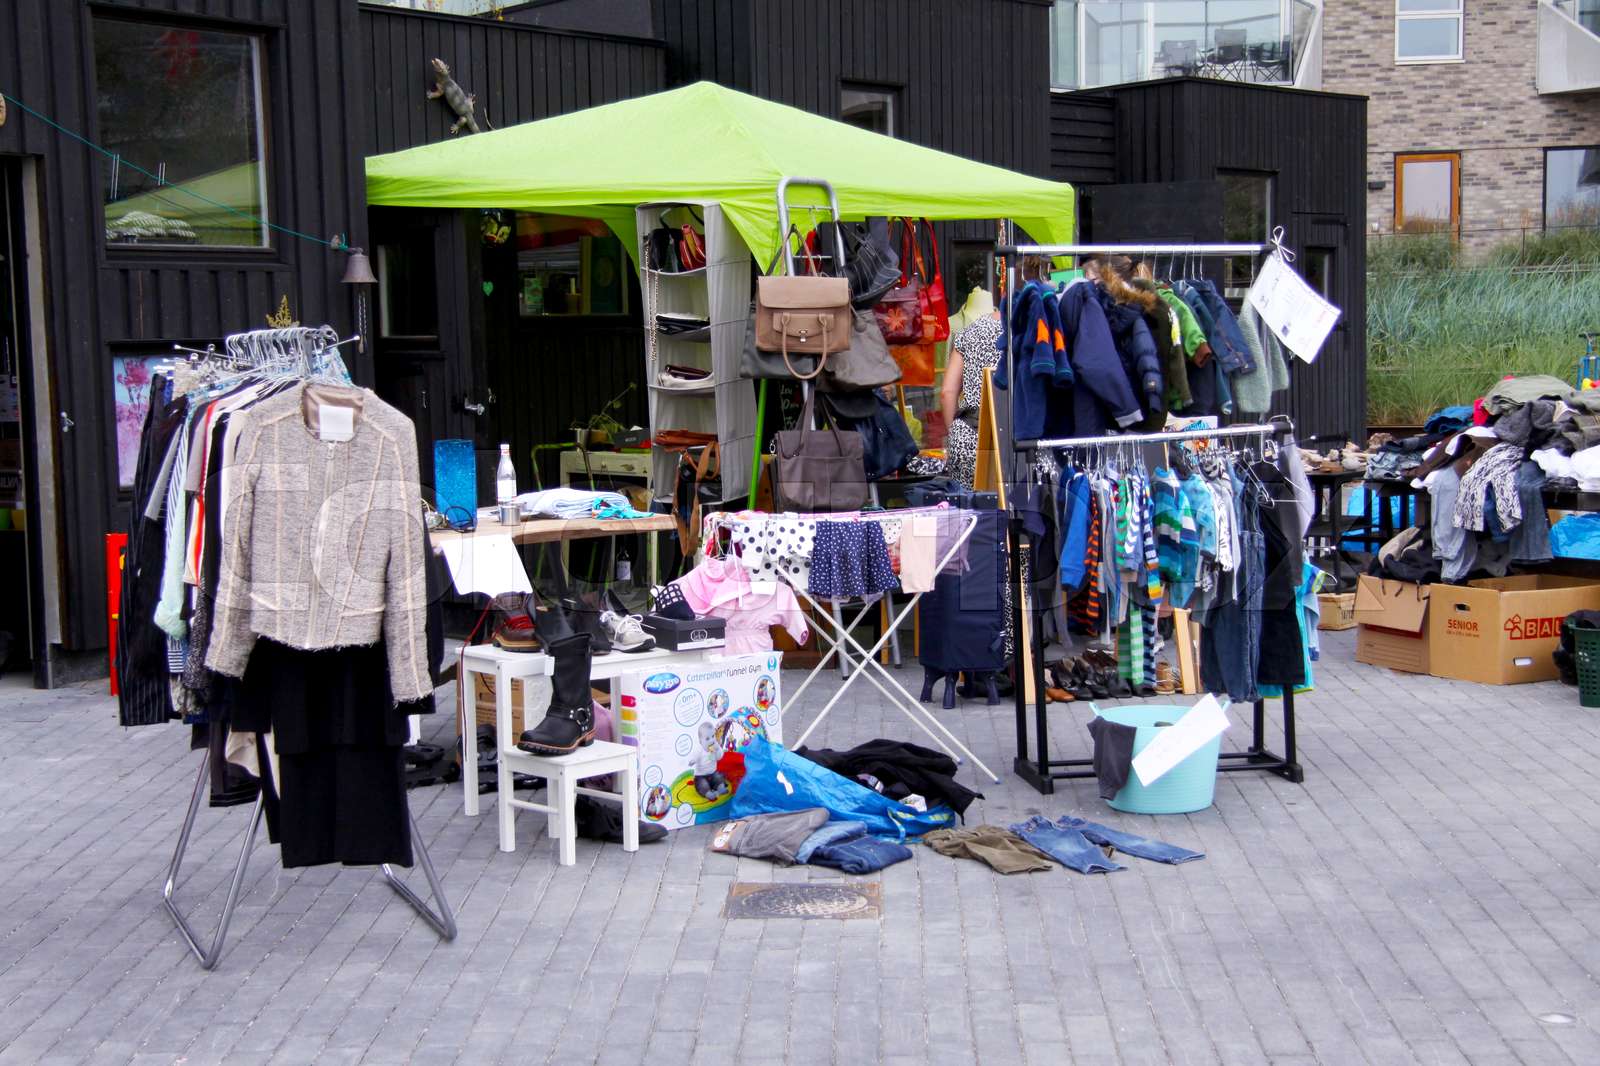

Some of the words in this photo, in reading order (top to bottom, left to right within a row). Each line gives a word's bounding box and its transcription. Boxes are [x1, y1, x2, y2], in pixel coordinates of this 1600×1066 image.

[1447, 619, 1479, 631] SENIOR
[726, 666, 747, 678] Tunnel
[748, 664, 762, 675] Gym
